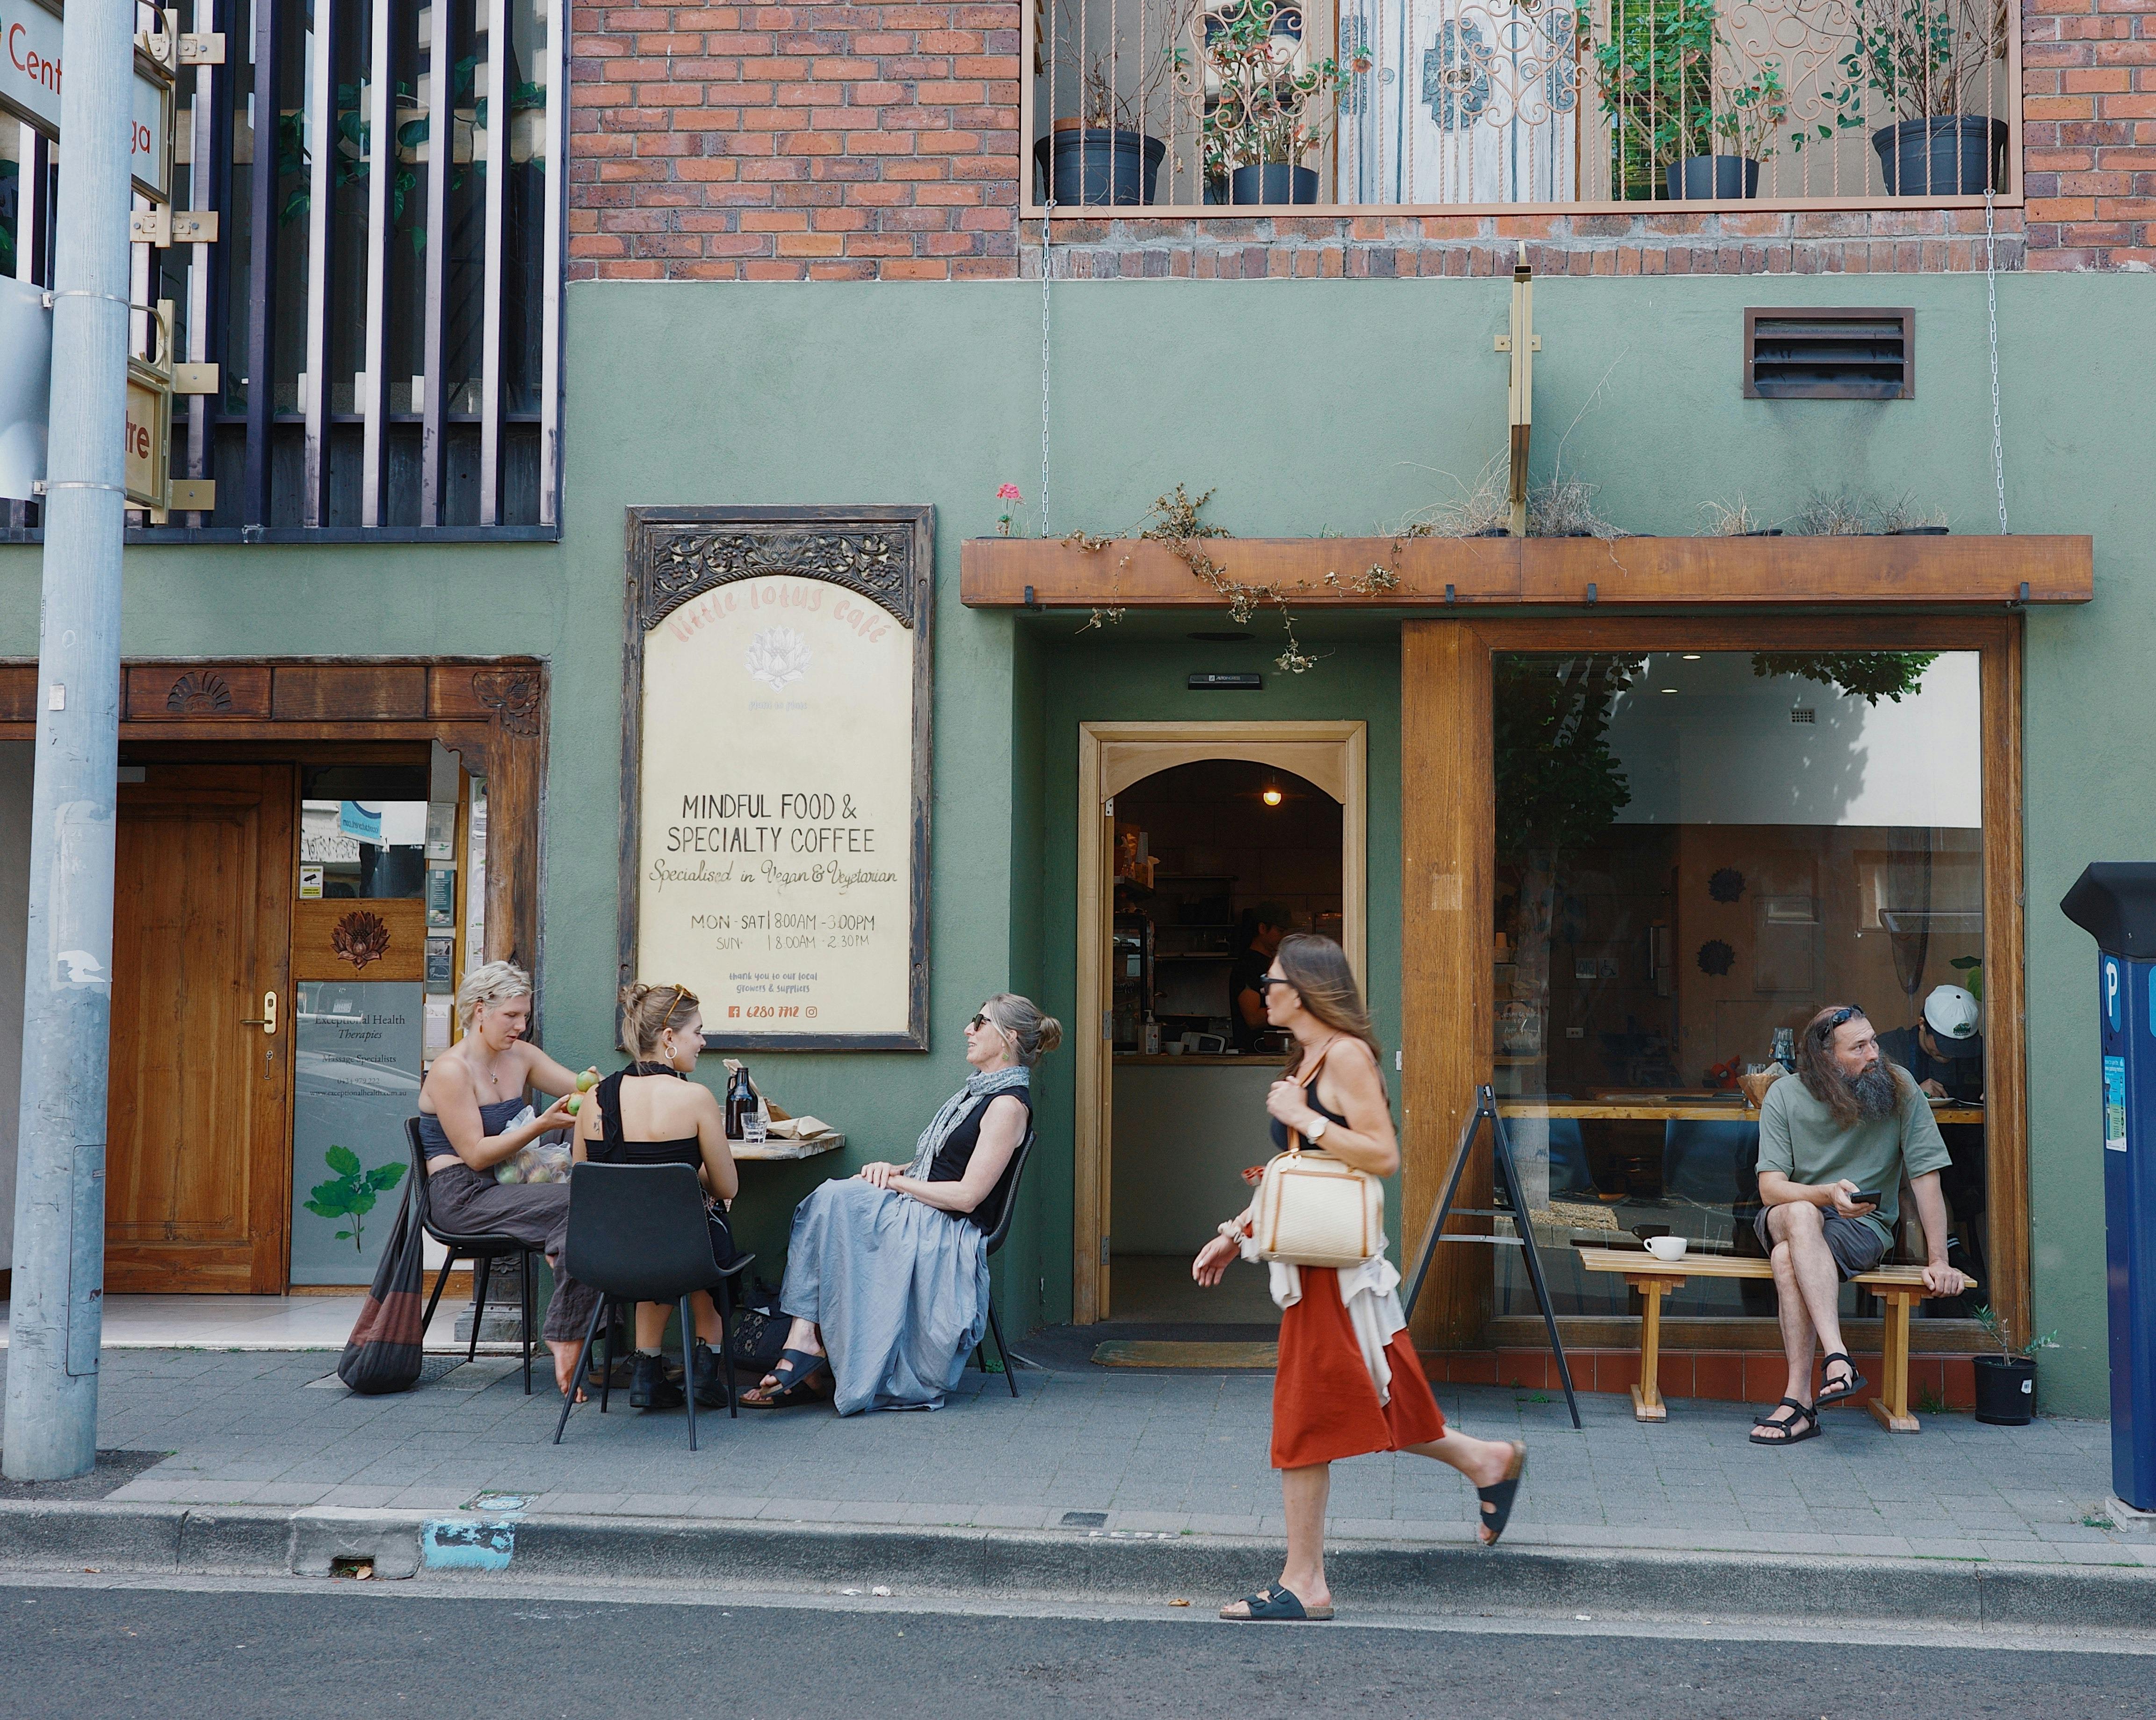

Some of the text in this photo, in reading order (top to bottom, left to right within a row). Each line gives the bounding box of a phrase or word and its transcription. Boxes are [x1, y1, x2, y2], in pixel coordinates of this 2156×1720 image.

[668, 582, 891, 643] little lotus café
[682, 794, 857, 820] MINDFUL FOOD &
[667, 826, 875, 853] SPECIALTY COFFEE
[649, 859, 897, 892] Specialised in Vegan & Vegetarian
[691, 915, 730, 929] MON
[741, 915, 766, 930] SAT
[774, 913, 816, 930] 8:00AM
[729, 972, 752, 981] thank
[754, 972, 769, 981] you
[798, 972, 818, 981] local
[736, 983, 810, 994] growers & suppliers
[746, 1006, 799, 1018] 6280 7712
[315, 1015, 405, 1027] Exceptional Health
[338, 1029, 382, 1042] Therapies
[322, 1054, 397, 1065] Massage Specialists
